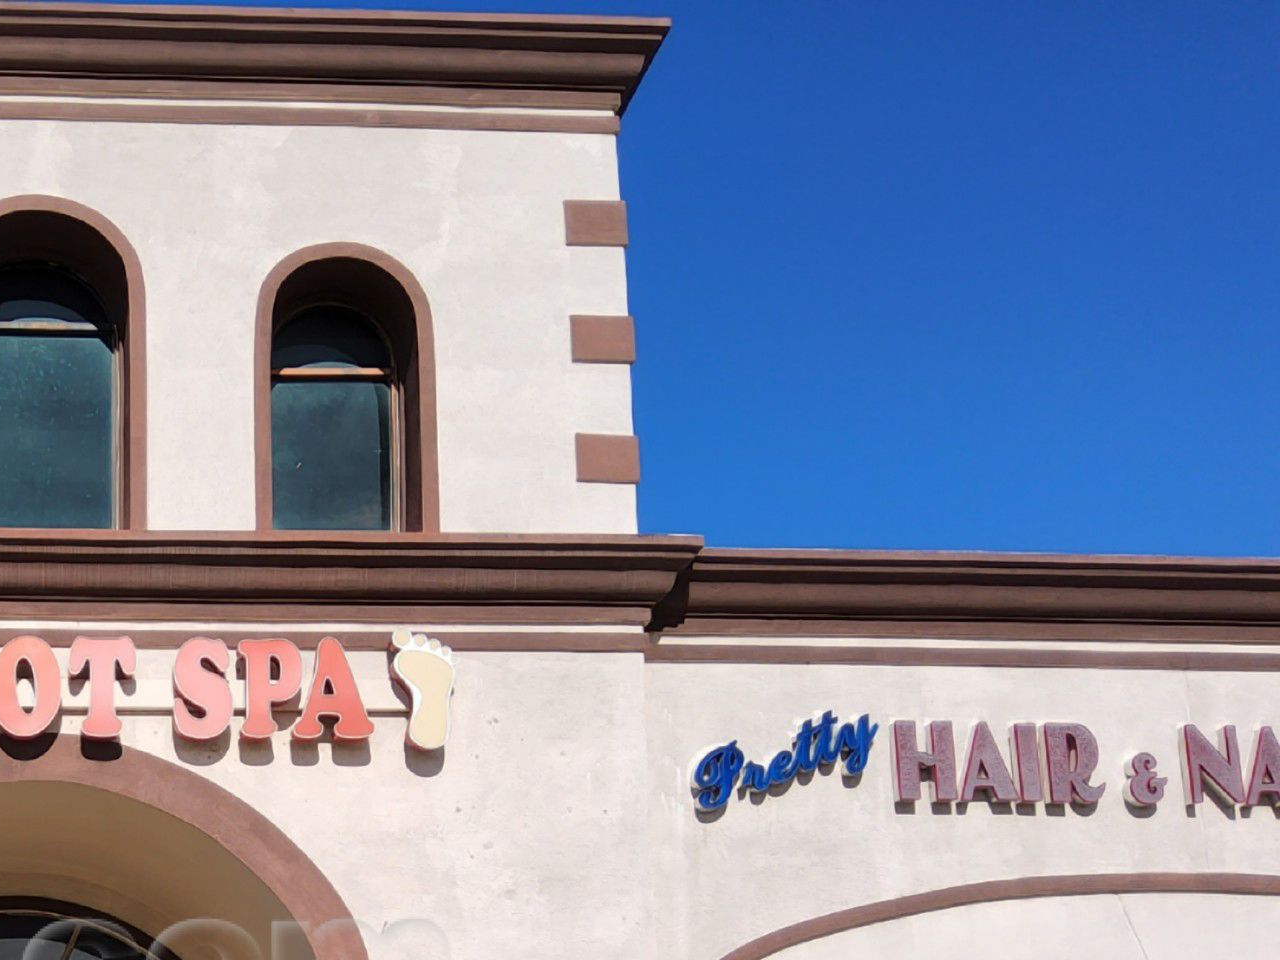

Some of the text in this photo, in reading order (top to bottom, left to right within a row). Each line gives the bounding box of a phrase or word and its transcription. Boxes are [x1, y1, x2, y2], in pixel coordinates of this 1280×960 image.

[171, 636, 376, 742] SPA
[694, 710, 879, 809] Pretty
[892, 720, 1107, 804] HAIR
[1127, 752, 1169, 806] &
